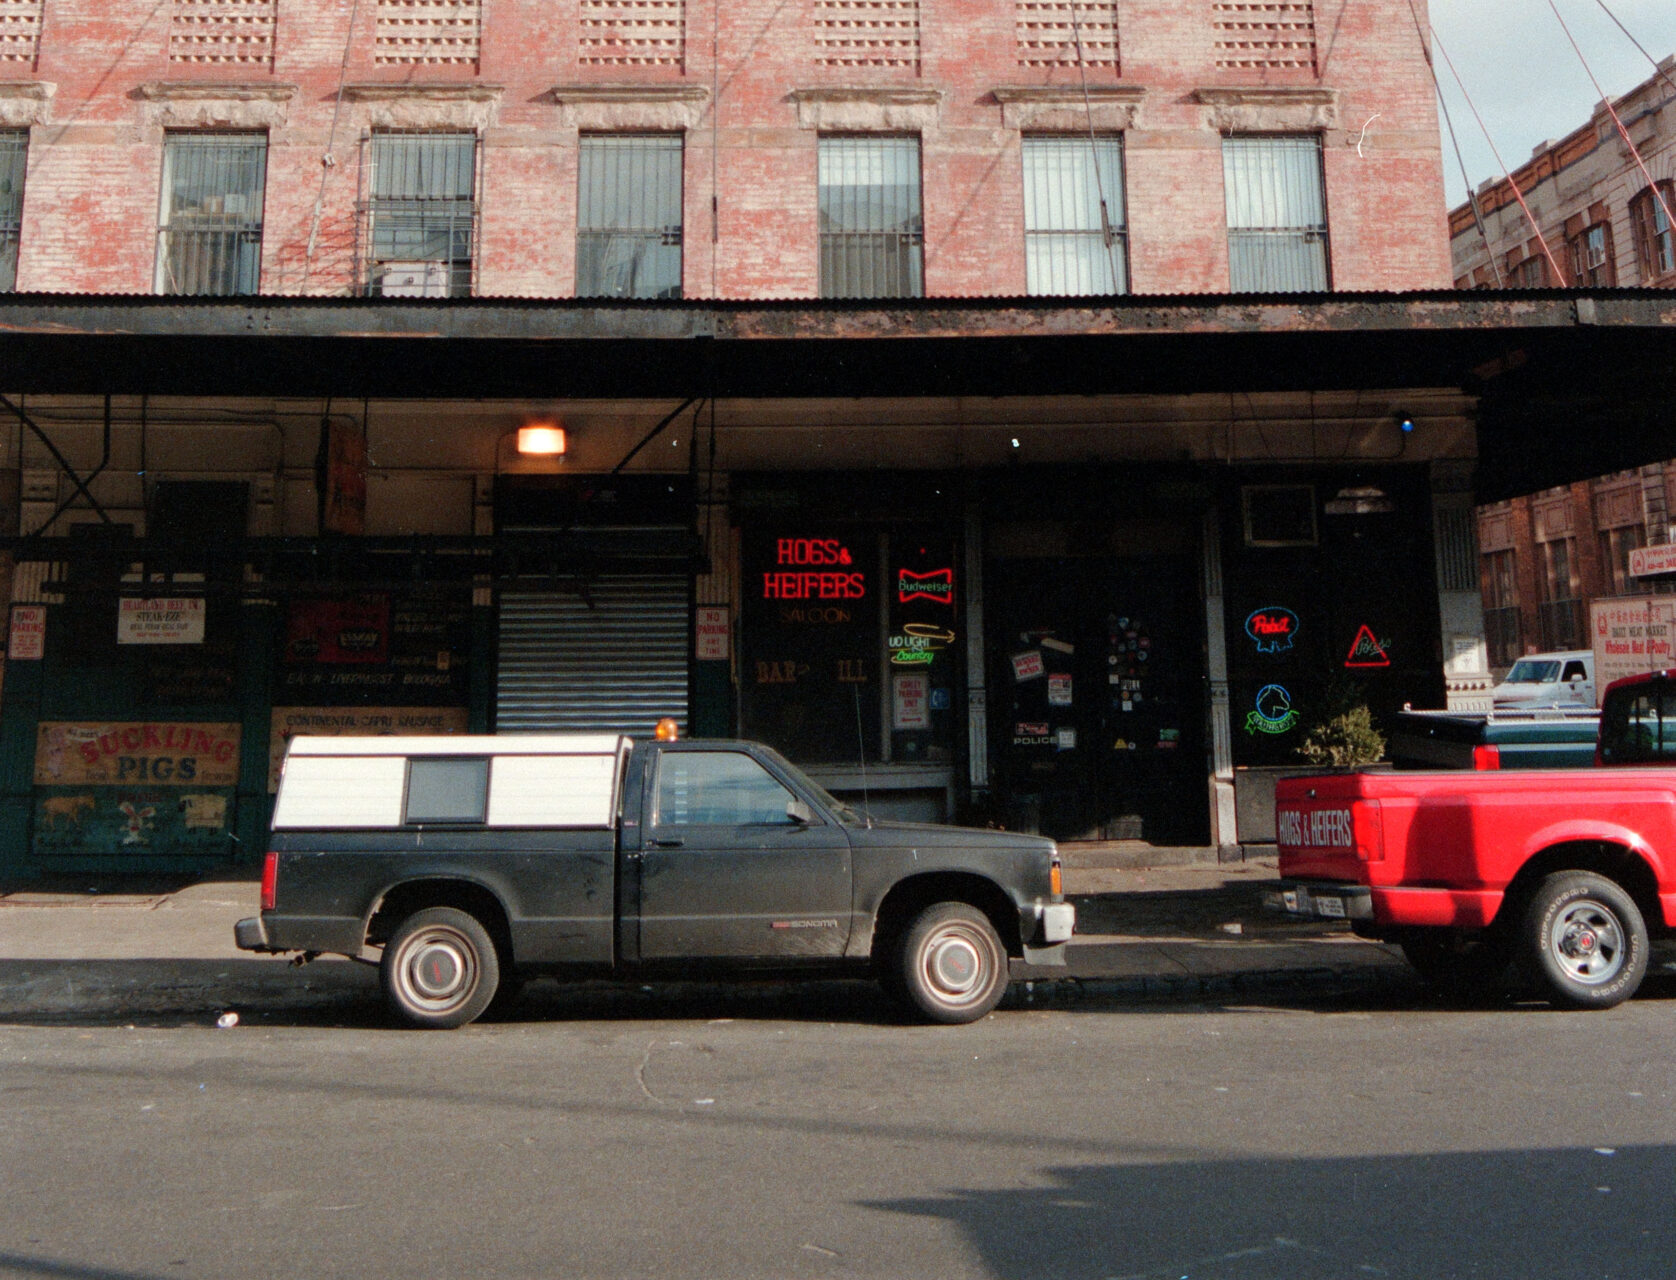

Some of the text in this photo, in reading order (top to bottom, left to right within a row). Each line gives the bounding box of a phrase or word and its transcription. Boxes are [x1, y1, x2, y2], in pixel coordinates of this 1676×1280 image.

[762, 572, 866, 600] HEIFERS
[898, 579, 953, 593] Budweiser
[706, 612, 720, 622] NO
[12, 623, 43, 633] PARKING
[697, 624, 729, 634] PARKING
[756, 660, 797, 683] BAR
[80, 724, 236, 764] SUCKLING
[1013, 735, 1058, 745] POLICE
[116, 756, 197, 780] PIGS
[1278, 809, 1352, 848] HOGS & HEIFERS
[791, 918, 838, 929] SONOMA
